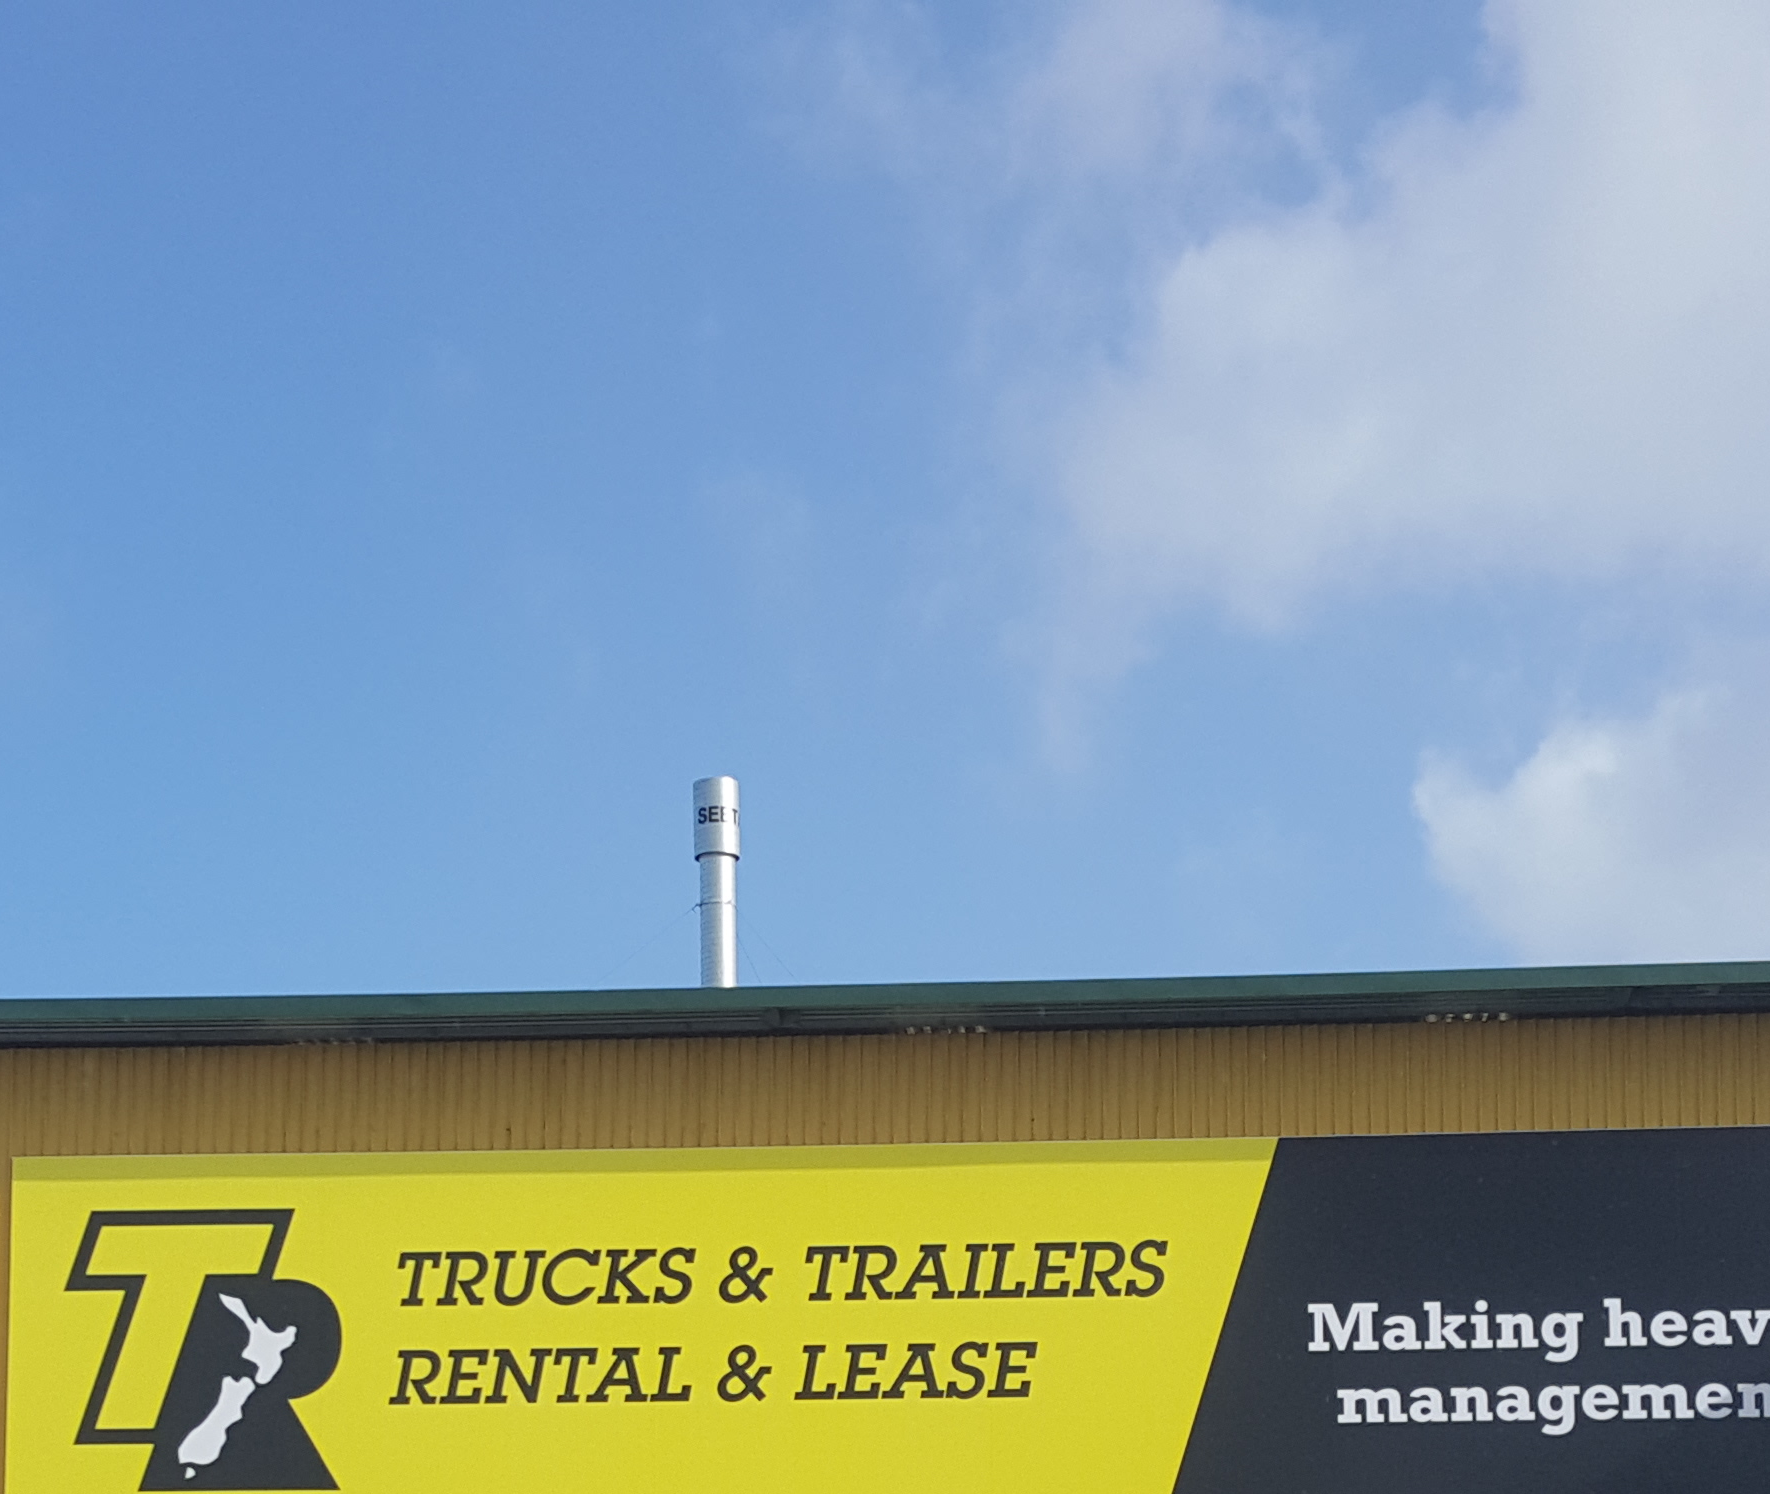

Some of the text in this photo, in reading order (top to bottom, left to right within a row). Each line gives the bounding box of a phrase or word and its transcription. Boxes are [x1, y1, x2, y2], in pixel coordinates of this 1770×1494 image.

[397, 1240, 1169, 1307] TRUCKS & TRAILERS
[1307, 1299, 1584, 1363] Making
[388, 1341, 1038, 1405] RENTAL & LEASE
